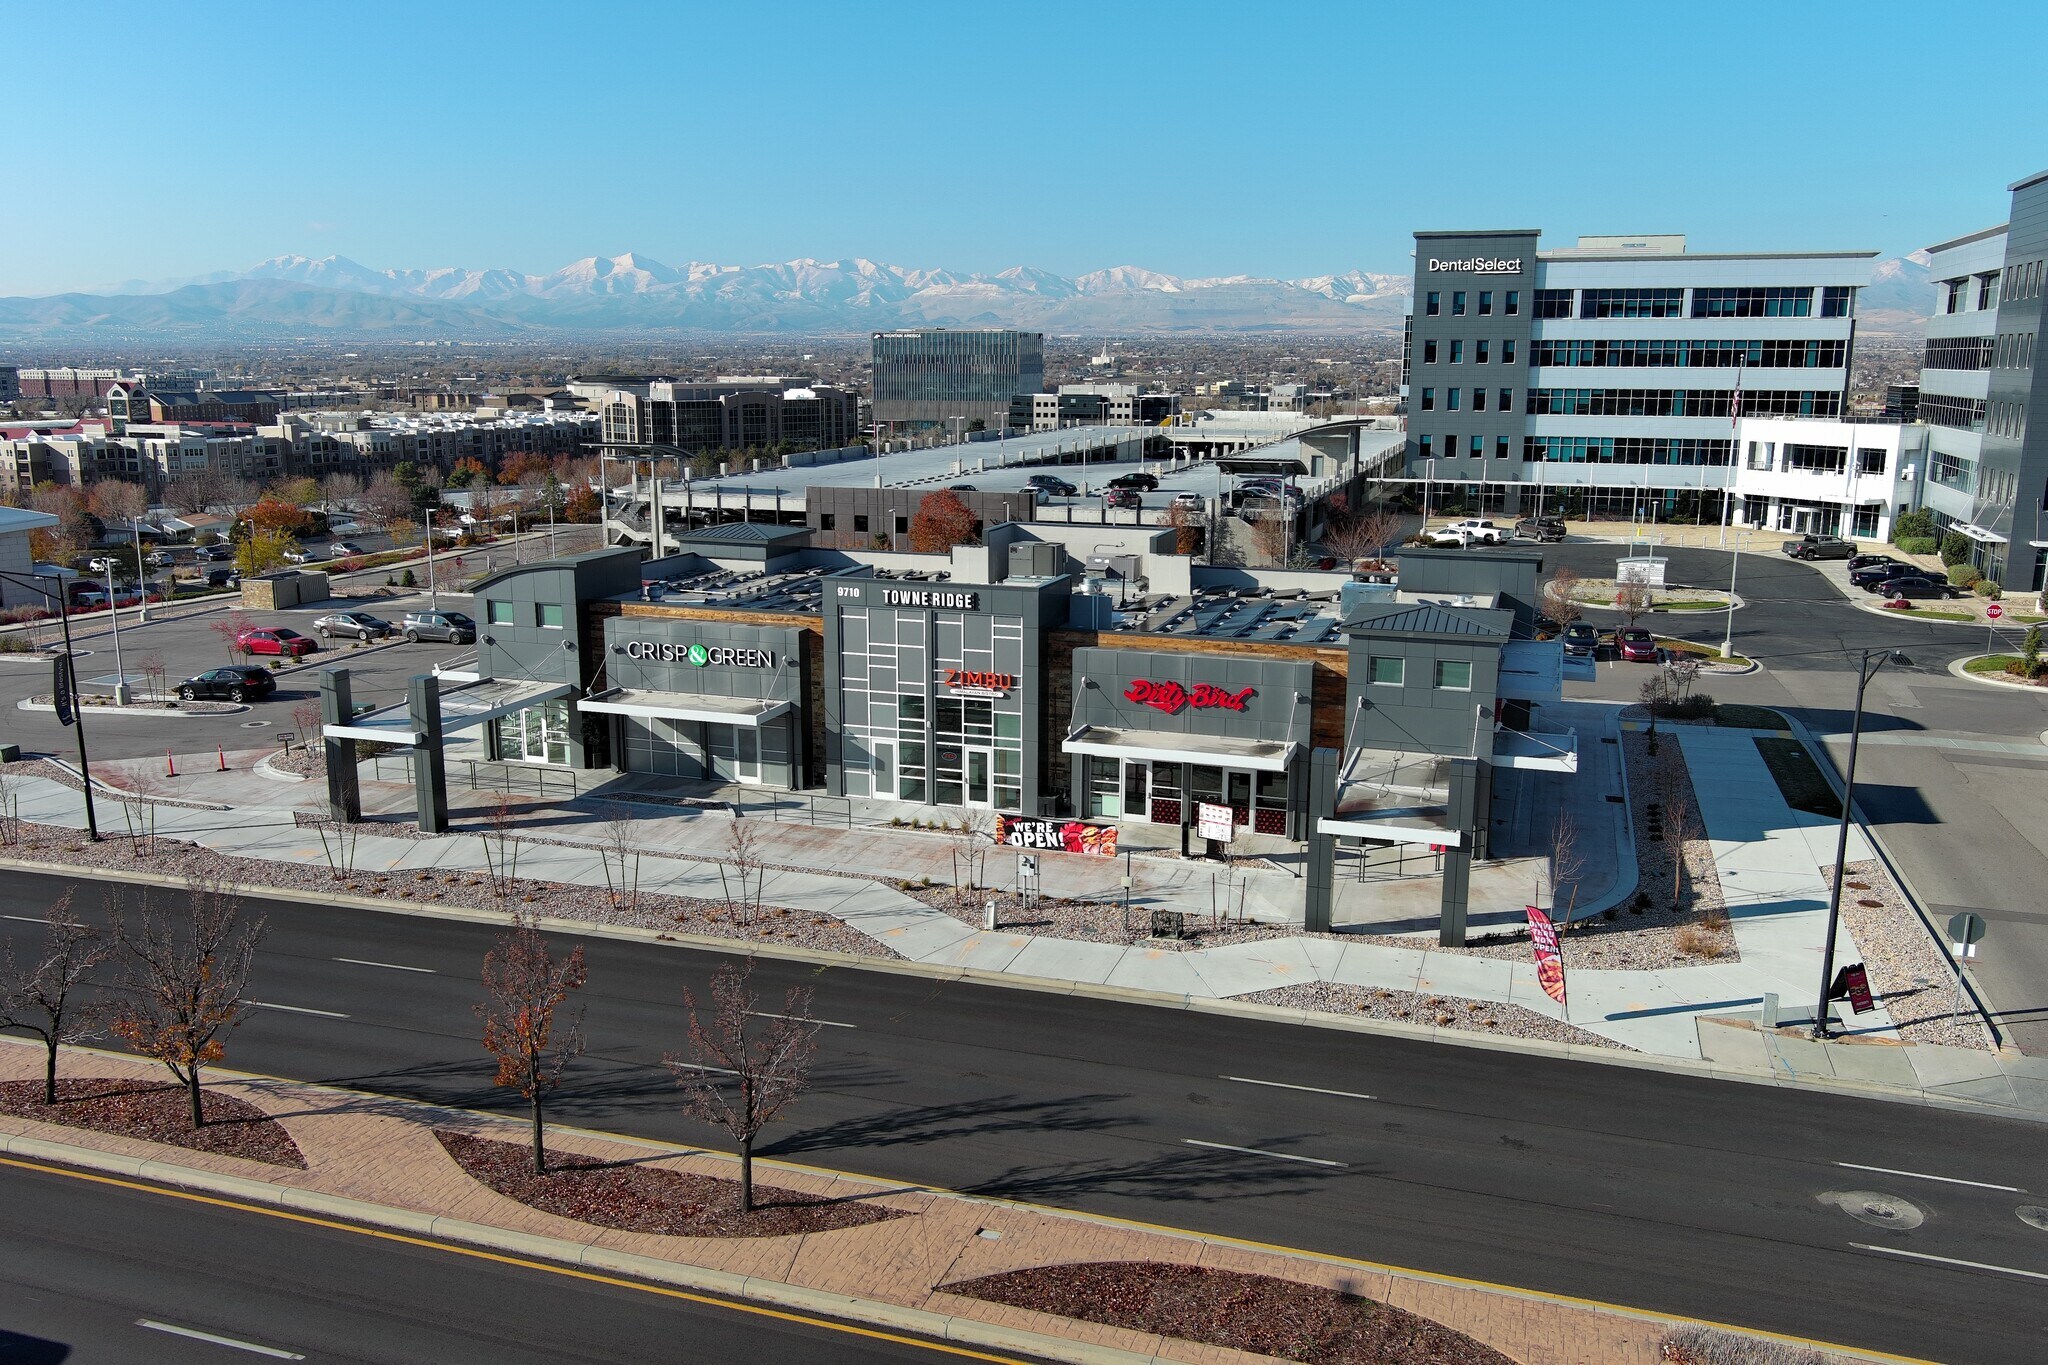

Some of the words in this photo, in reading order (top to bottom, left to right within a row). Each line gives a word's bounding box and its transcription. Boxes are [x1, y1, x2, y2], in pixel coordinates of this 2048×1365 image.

[1429, 257, 1521, 272] DentalSelect
[837, 586, 860, 598] 9710
[882, 589, 929, 606] TOWNE
[932, 591, 972, 608] RIDGE
[944, 668, 1011, 690] ZIMBU
[1124, 678, 1186, 714] Dirty
[1187, 683, 1254, 711] Bird
[1013, 821, 1053, 833] WE'RE
[1010, 832, 1065, 848] OPEN!
[1529, 920, 1553, 931] DRIVE
[1532, 928, 1555, 938] THRU
[1534, 935, 1554, 945] NOW
